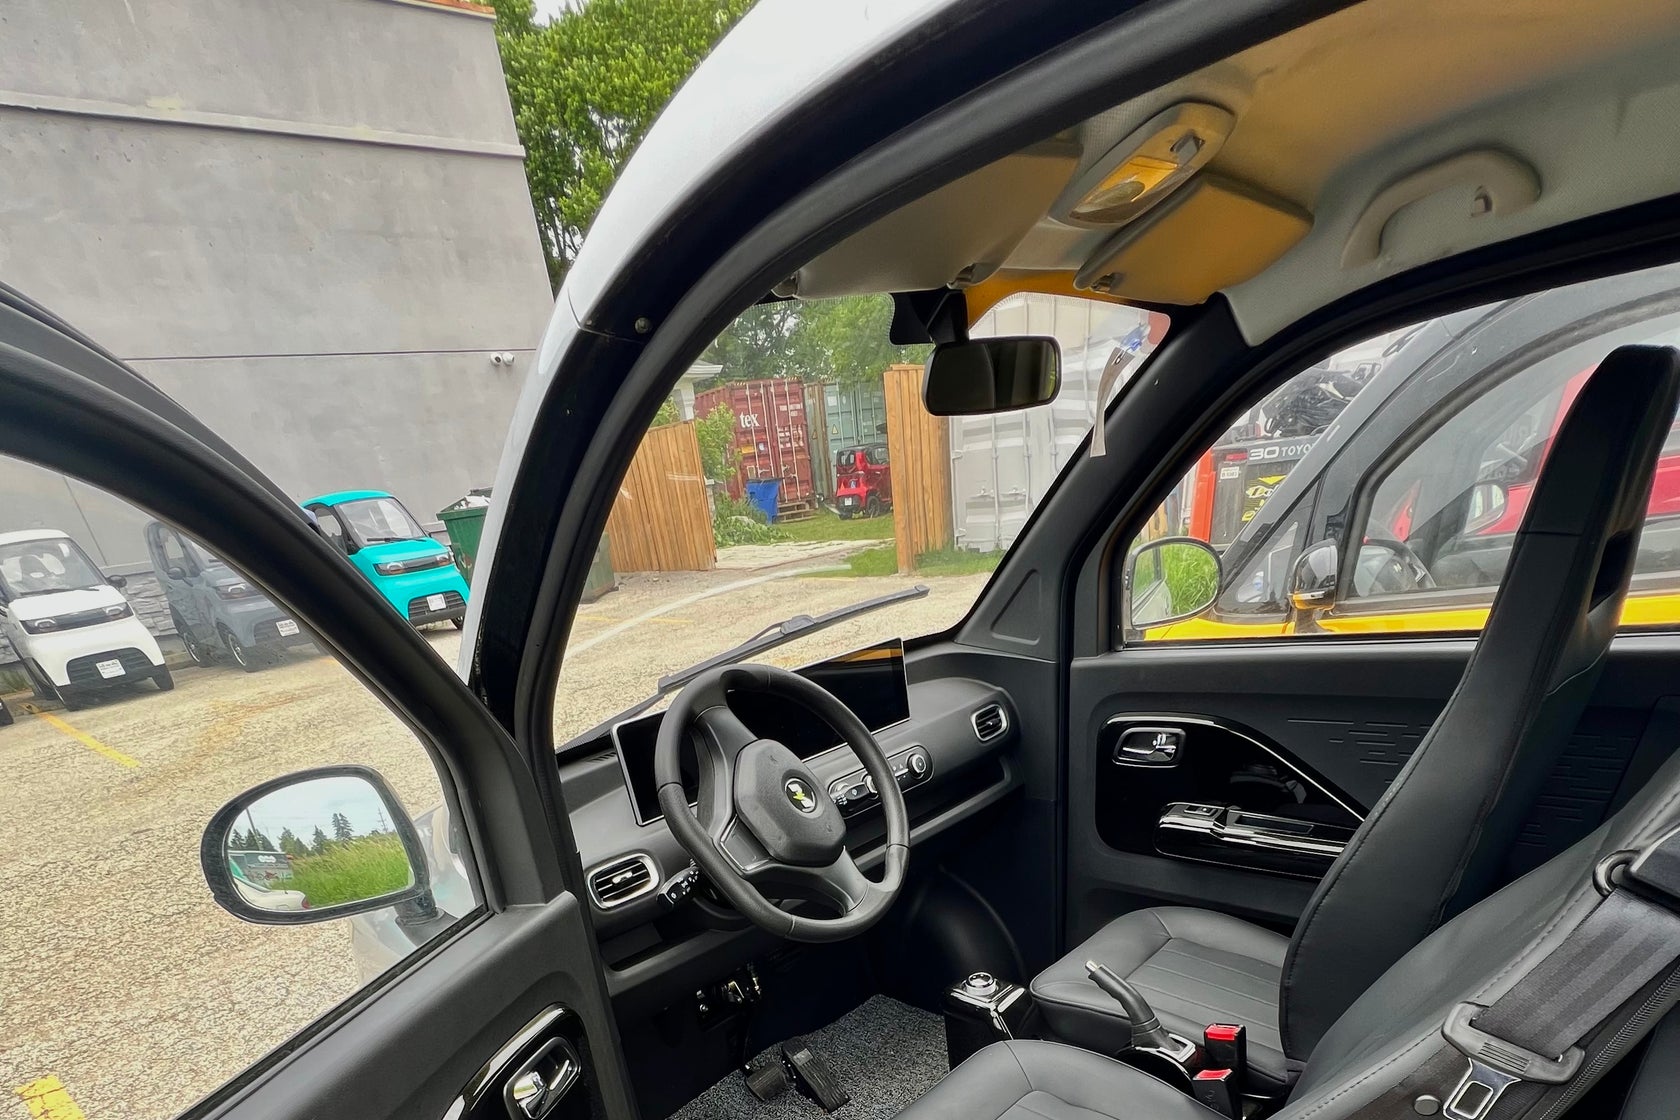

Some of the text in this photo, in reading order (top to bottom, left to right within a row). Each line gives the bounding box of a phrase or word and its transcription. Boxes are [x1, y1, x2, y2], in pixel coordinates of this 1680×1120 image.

[739, 411, 761, 428] tex
[1249, 444, 1314, 461] 30 TOYO
